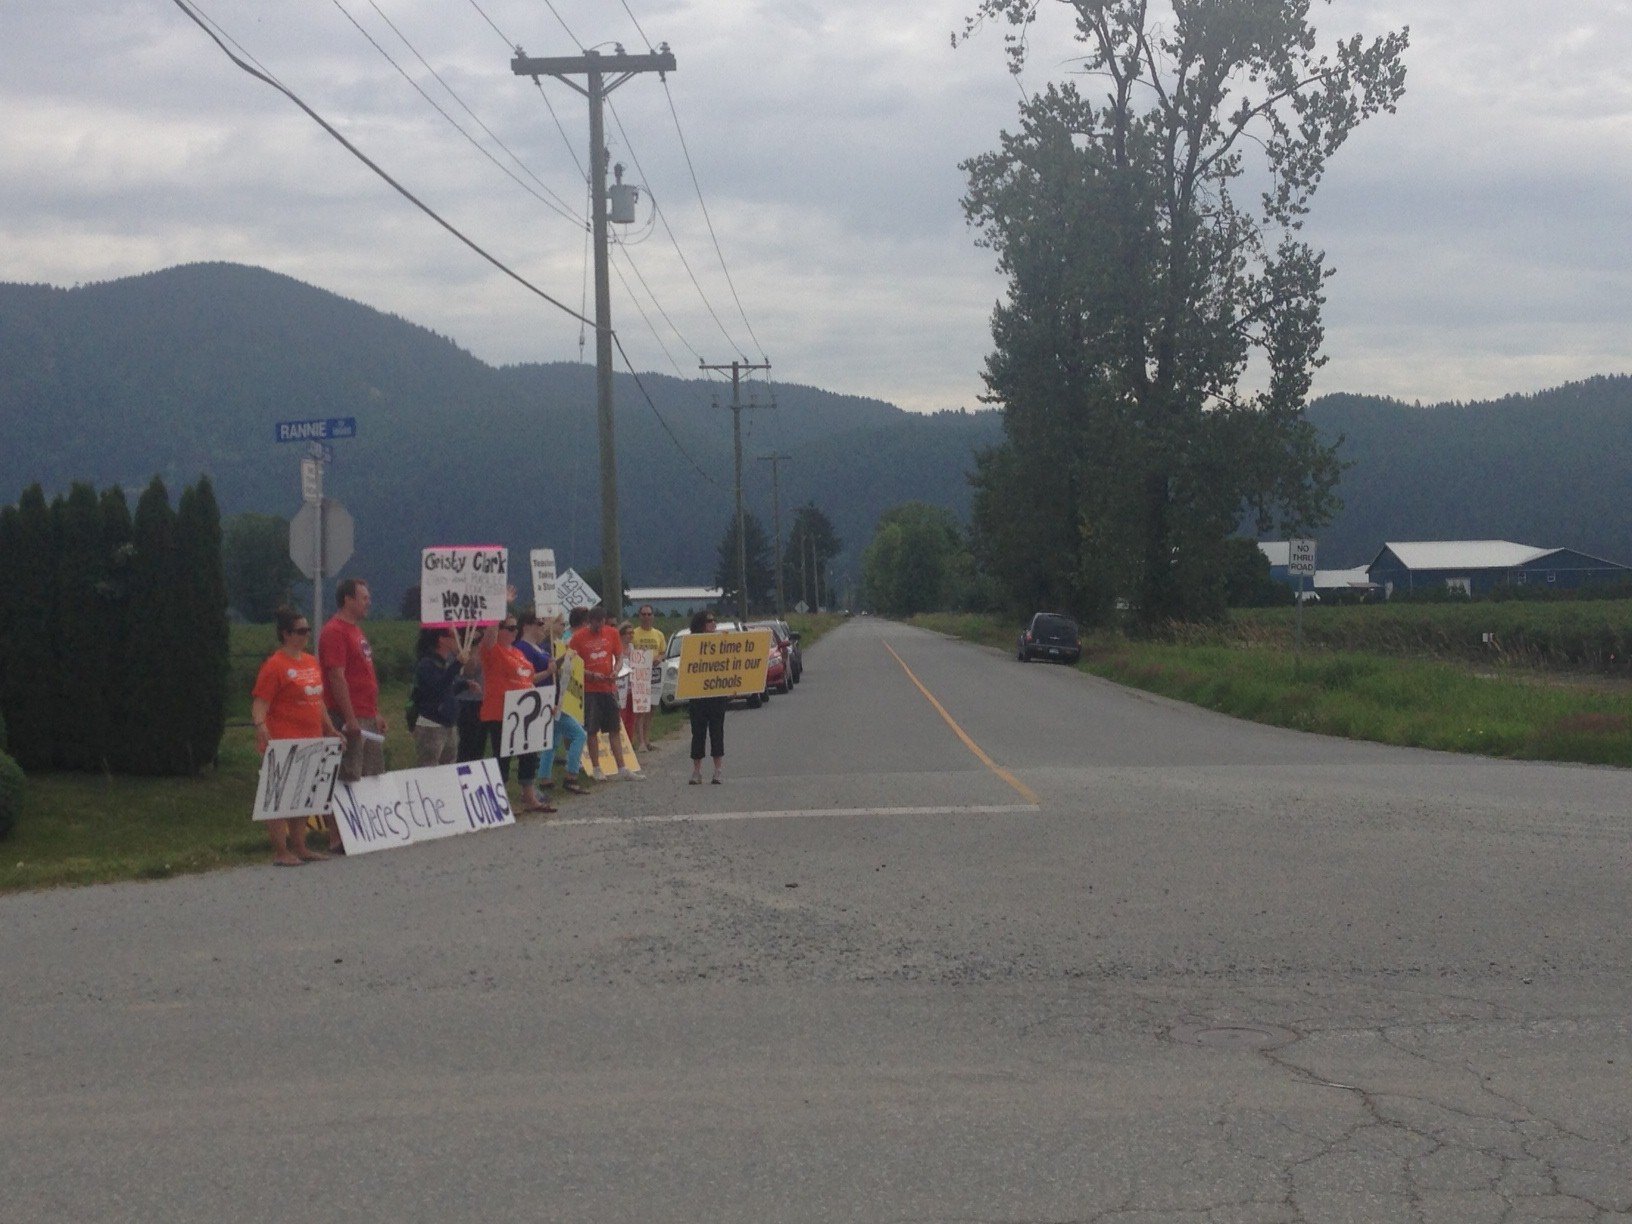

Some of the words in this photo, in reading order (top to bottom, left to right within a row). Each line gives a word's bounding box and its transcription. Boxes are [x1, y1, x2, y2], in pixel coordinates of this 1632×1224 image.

[280, 421, 327, 439] RANNIE
[1293, 553, 1313, 561] THRU
[1290, 563, 1313, 571] ROAD
[699, 641, 716, 655] It's
[719, 640, 742, 654] time
[744, 639, 755, 653] to
[687, 658, 730, 673] reinvest
[732, 657, 742, 671] in
[744, 658, 761, 670] our
[703, 675, 742, 690] schools
[405, 779, 455, 828] the
[456, 760, 510, 828] Funds
